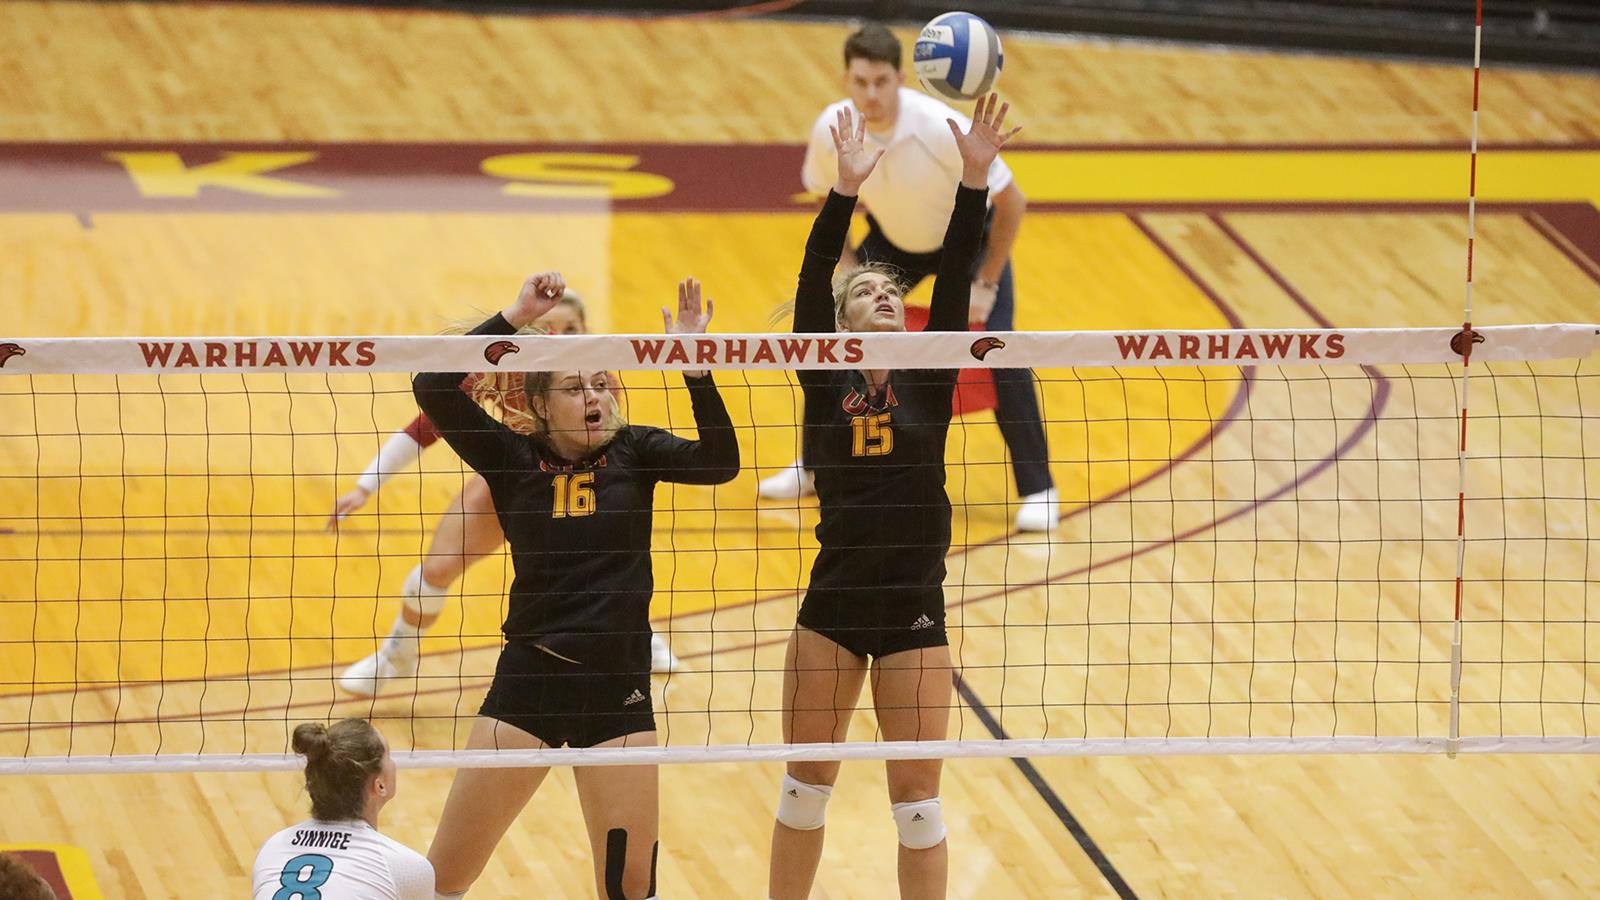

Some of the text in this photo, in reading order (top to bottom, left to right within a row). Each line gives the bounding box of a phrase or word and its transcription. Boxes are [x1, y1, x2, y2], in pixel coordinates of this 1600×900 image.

[138, 333, 1346, 368] WARHAWKS WARHAWKS WARHAWKS
[850, 413, 894, 457] 15
[551, 471, 596, 518] 16
[291, 829, 352, 850] SINNIGE
[271, 853, 334, 900] 8
